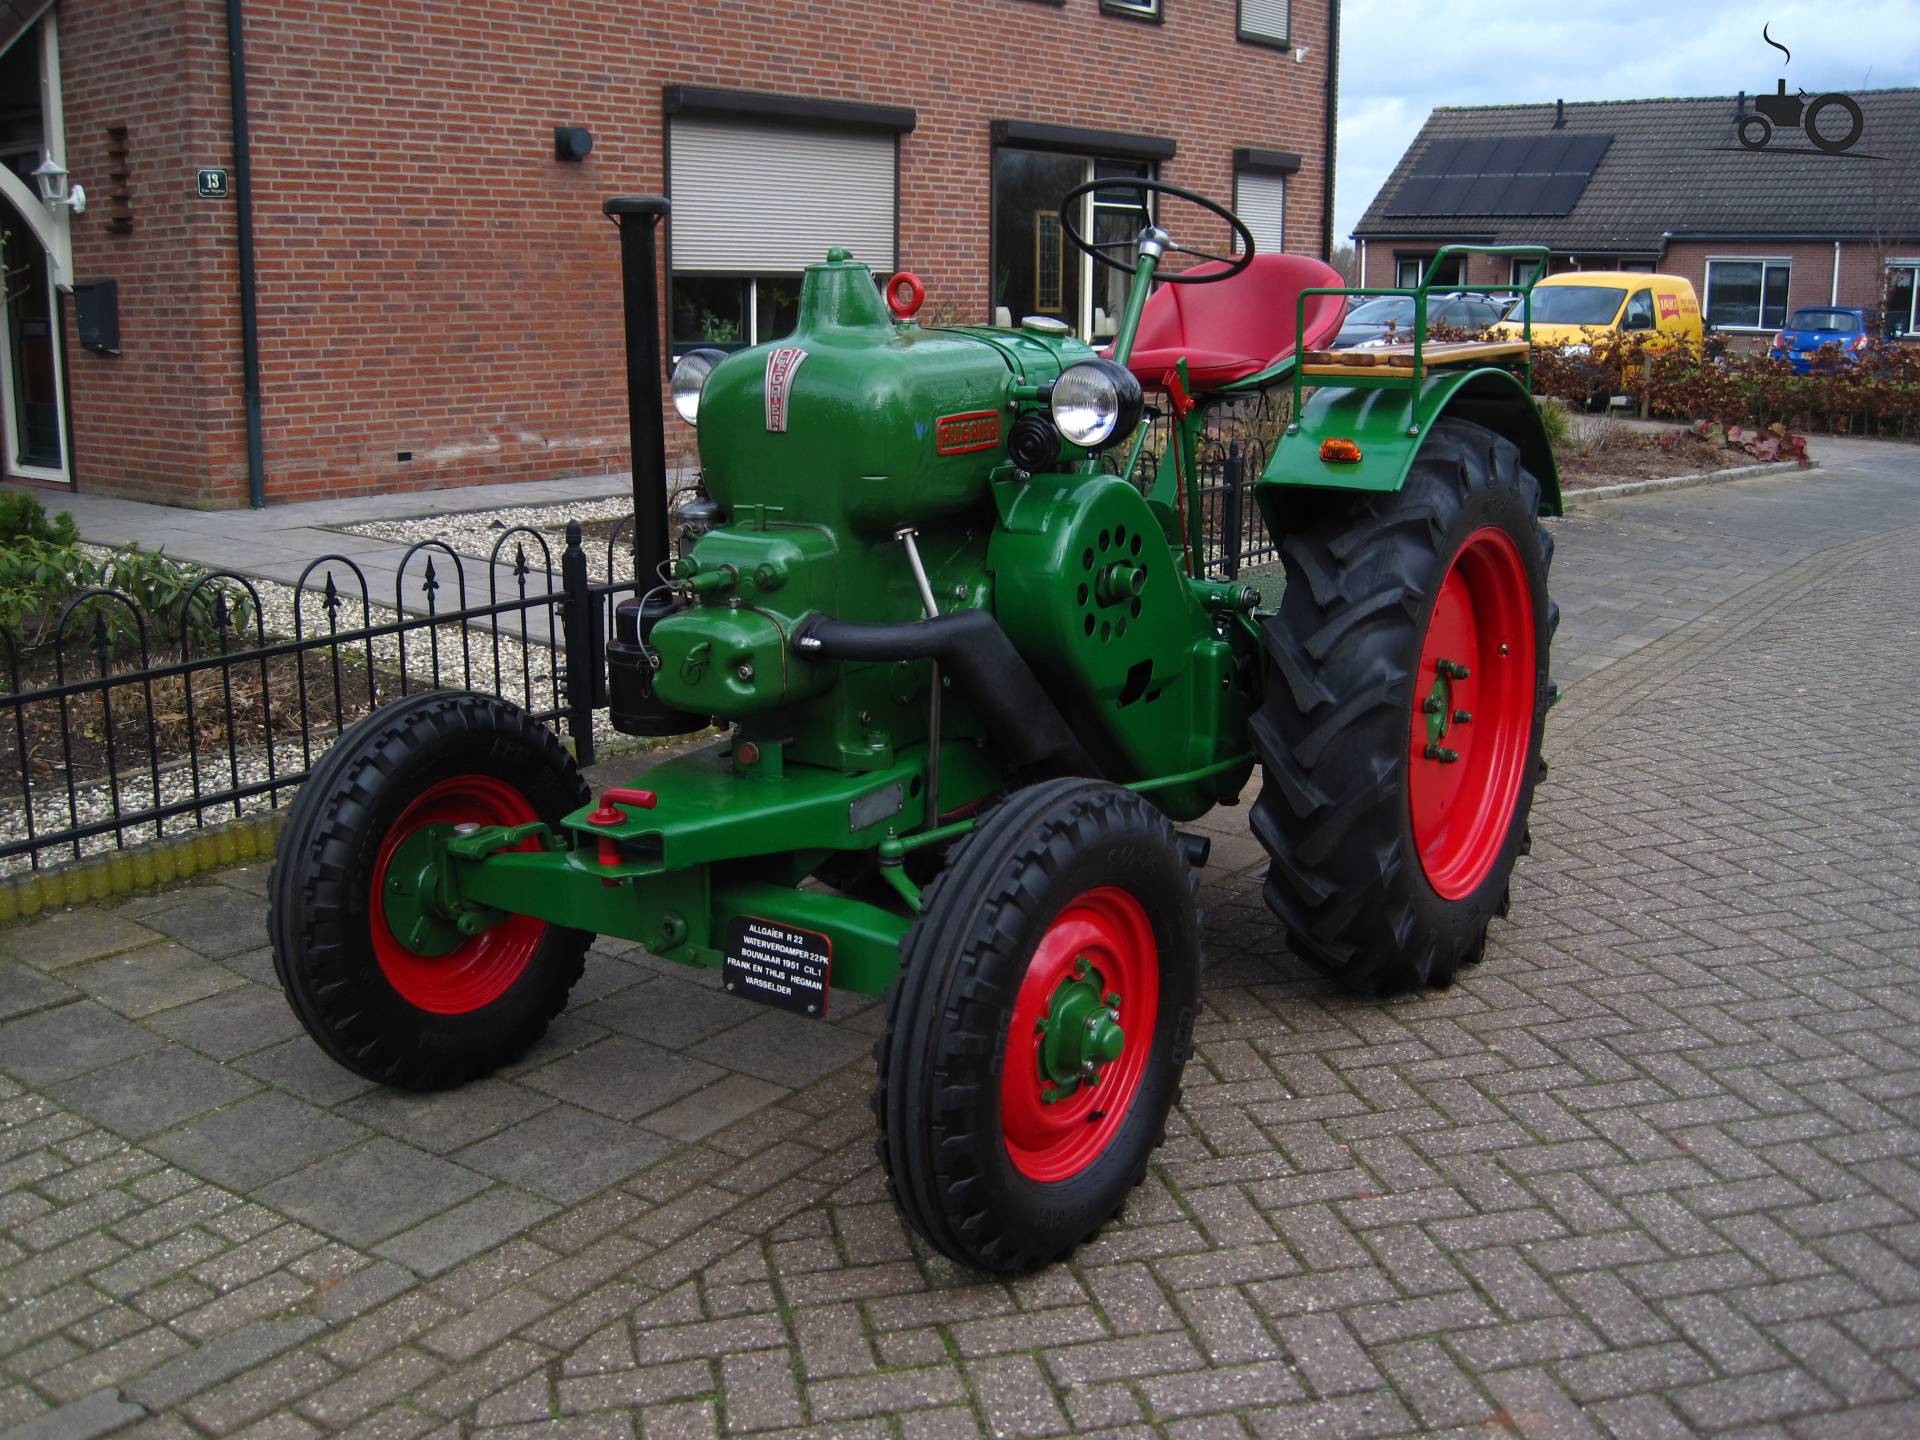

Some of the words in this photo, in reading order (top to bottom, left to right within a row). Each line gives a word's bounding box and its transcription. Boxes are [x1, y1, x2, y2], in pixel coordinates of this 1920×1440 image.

[207, 174, 219, 188] 13
[743, 935, 809, 959] WATERVERDAMPER
[787, 934, 793, 942] R
[794, 935, 803, 945] 22
[741, 948, 780, 965] BOUWJAAR
[783, 959, 799, 970] 1951
[727, 957, 751, 970] FRANK
[753, 964, 762, 973] EN
[765, 967, 785, 980] THIJS
[790, 974, 822, 991] HEGMAN
[745, 975, 791, 995] VARSSELDER
